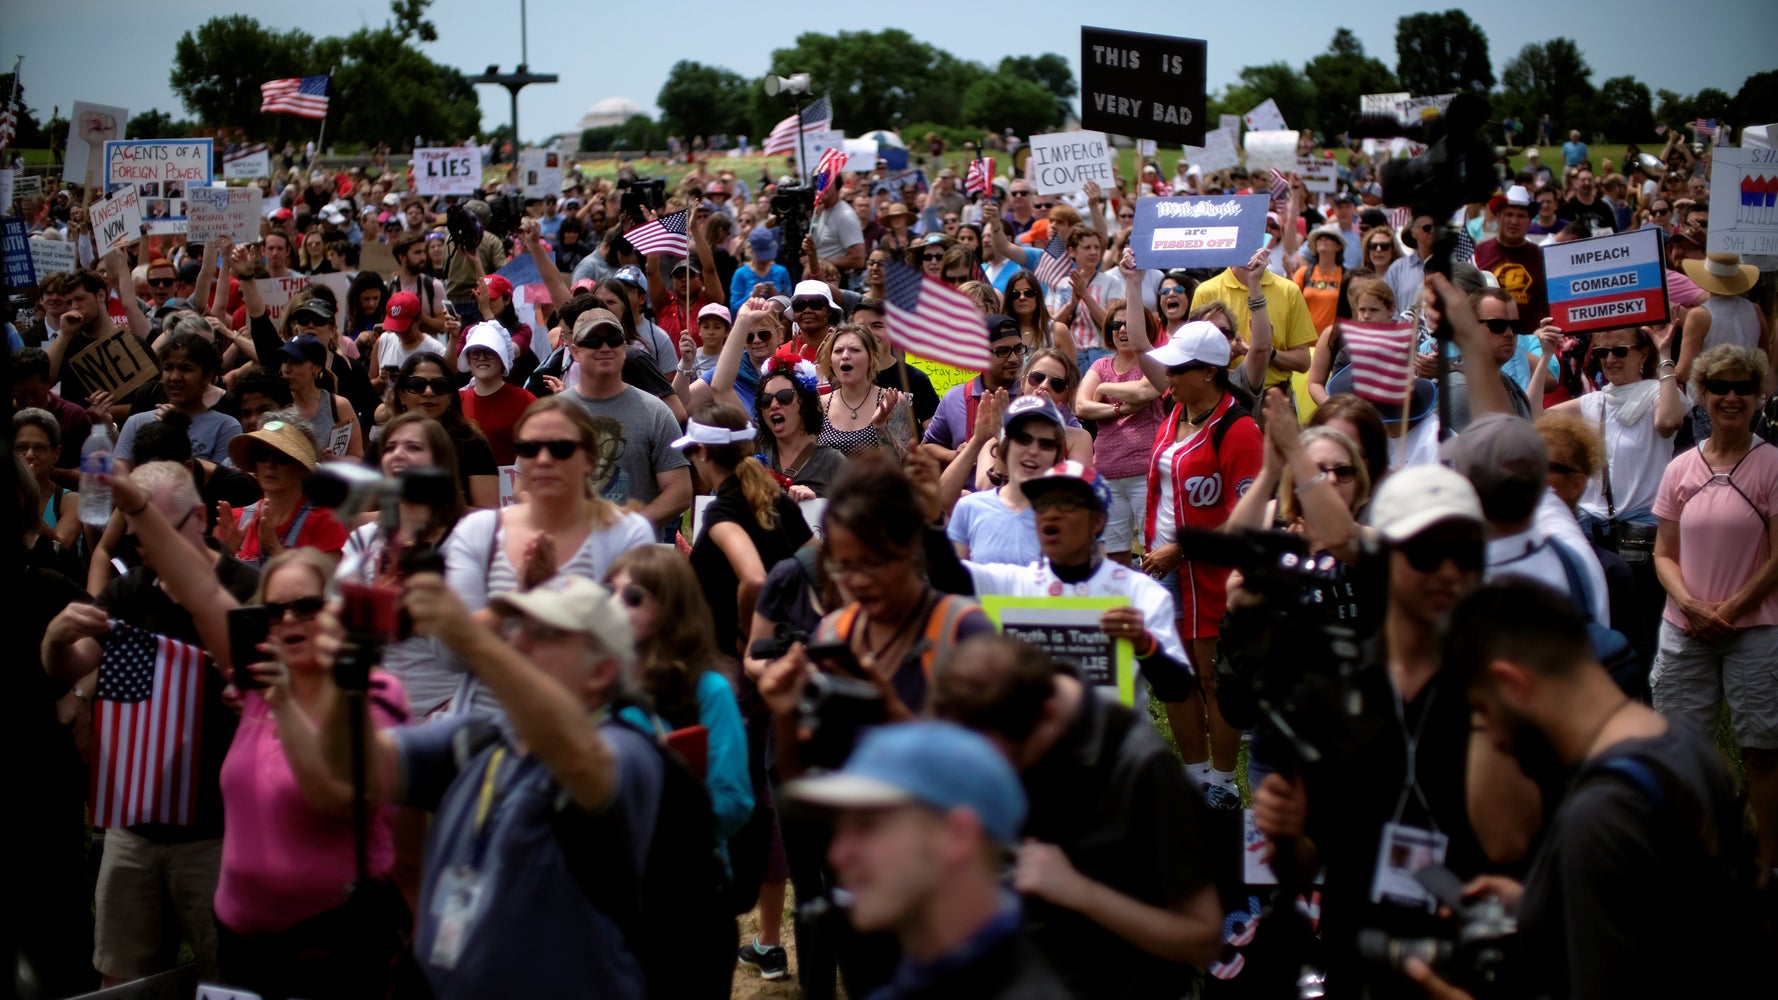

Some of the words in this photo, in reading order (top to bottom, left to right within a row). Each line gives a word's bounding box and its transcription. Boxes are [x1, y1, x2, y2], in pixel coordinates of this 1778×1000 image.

[1092, 44, 1141, 70] THIS
[1161, 53, 1184, 75] IS
[1093, 92, 1143, 118] VERY
[1152, 102, 1193, 126] BAD
[111, 145, 168, 161] AGENTS
[176, 147, 189, 157] OF
[192, 146, 200, 158] A
[1035, 141, 1104, 166] IMPEACH
[112, 162, 158, 179] FOREIGN
[165, 162, 203, 180] POWER
[427, 158, 471, 178] LIES
[191, 189, 212, 200] YOU
[91, 191, 137, 228] INVESTIGATE
[191, 213, 224, 222] CAUSING
[5, 222, 22, 234] THE
[103, 214, 126, 244] NOW
[191, 223, 229, 232] DECLINE
[1184, 228, 1207, 236] are
[2, 235, 25, 252] UTH
[1153, 239, 1204, 250] PISSED
[1207, 238, 1235, 248] OFF
[1570, 246, 1630, 266] IMPEACH
[1571, 273, 1637, 293] COMRADE
[1570, 300, 1644, 320] TRUMPSKY
[72, 330, 141, 393] NYET
[926, 365, 951, 383] Stay
[1185, 472, 1223, 508] W
[1051, 629, 1064, 644] is
[1067, 629, 1111, 644] Truth
[1081, 655, 1110, 671] LIE
